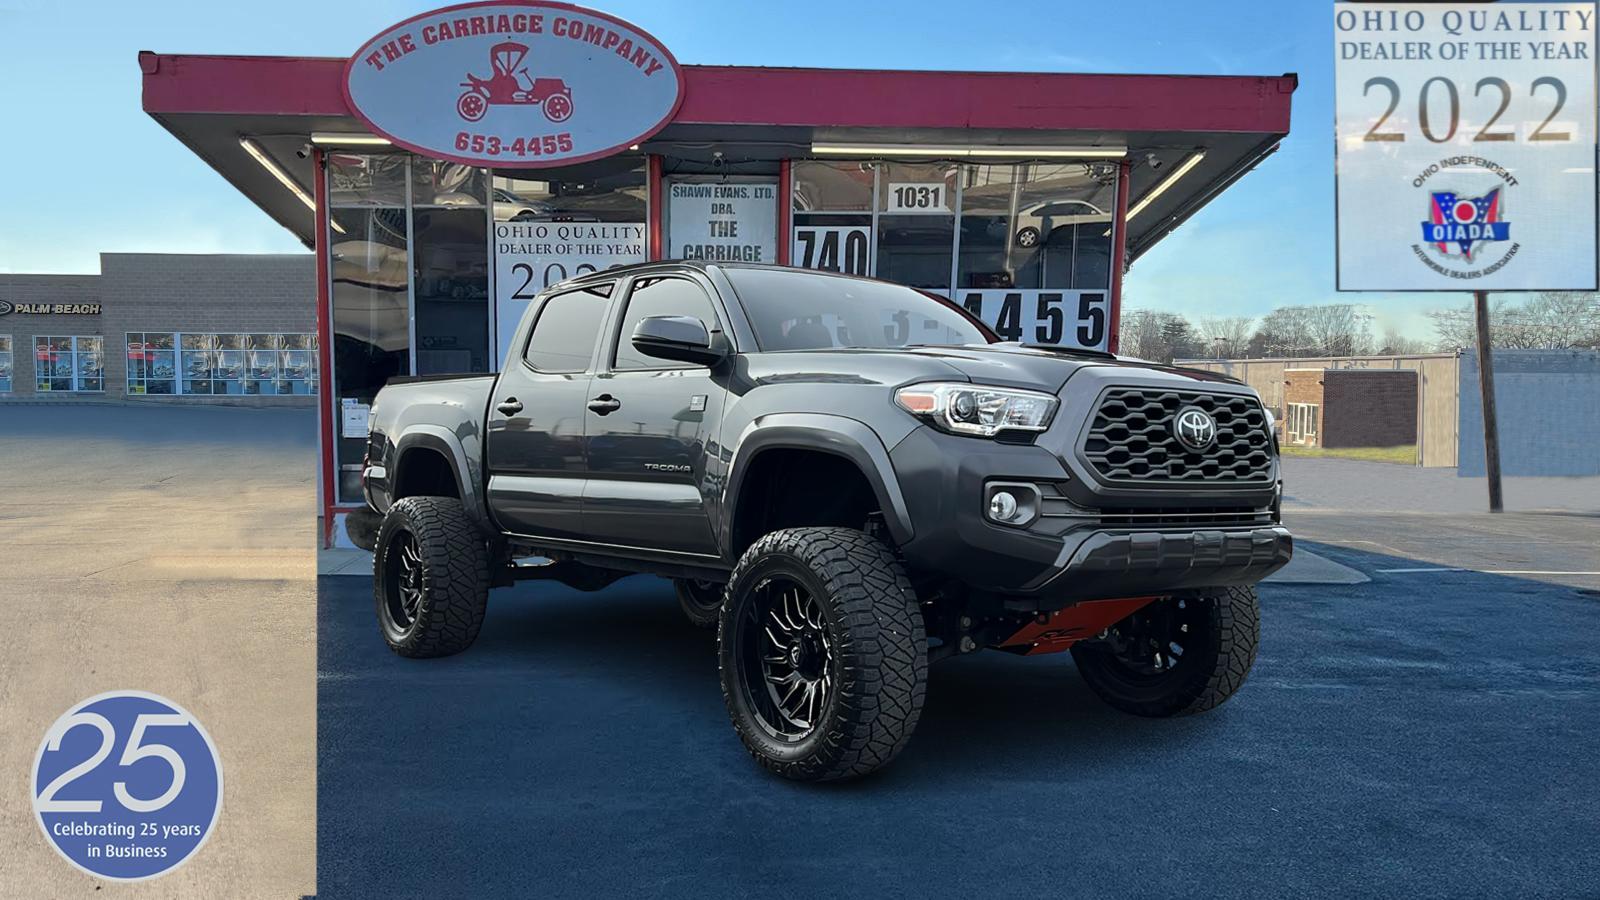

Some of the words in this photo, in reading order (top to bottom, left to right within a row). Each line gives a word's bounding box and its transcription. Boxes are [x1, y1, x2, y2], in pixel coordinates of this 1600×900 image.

[1336, 10, 1425, 32] OHIO
[1442, 10, 1593, 35] QUALITY
[366, 33, 416, 71] THE
[422, 14, 544, 45] CARRIAGE
[552, 17, 664, 77] COMPANY
[1340, 41, 1433, 60] DEALER
[1439, 41, 1469, 60] OF
[1475, 41, 1522, 60] THE
[1528, 41, 1589, 60] YEAR
[1363, 76, 1571, 143] 2022
[455, 131, 573, 156] 653-4455
[1412, 163, 1440, 188] OHIO
[1439, 155, 1519, 187] INDEPENDENT
[672, 186, 713, 199] SHAWN
[754, 187, 774, 199] LTD.
[894, 186, 941, 208] 1031
[711, 203, 736, 215] DBA.
[497, 226, 548, 239] OHIO
[558, 226, 644, 241] QUALITY
[708, 221, 738, 238] THE
[1432, 224, 1496, 241] OIADA
[499, 243, 551, 255] DEALER
[555, 243, 573, 255] OF
[576, 243, 603, 255] THE
[606, 243, 641, 255] YEAR
[683, 244, 762, 262] CARRIAGE
[798, 231, 868, 277] 740
[1449, 270, 1482, 280] DEALERS
[14, 303, 51, 314] PALM
[644, 463, 692, 472] TACOMA
